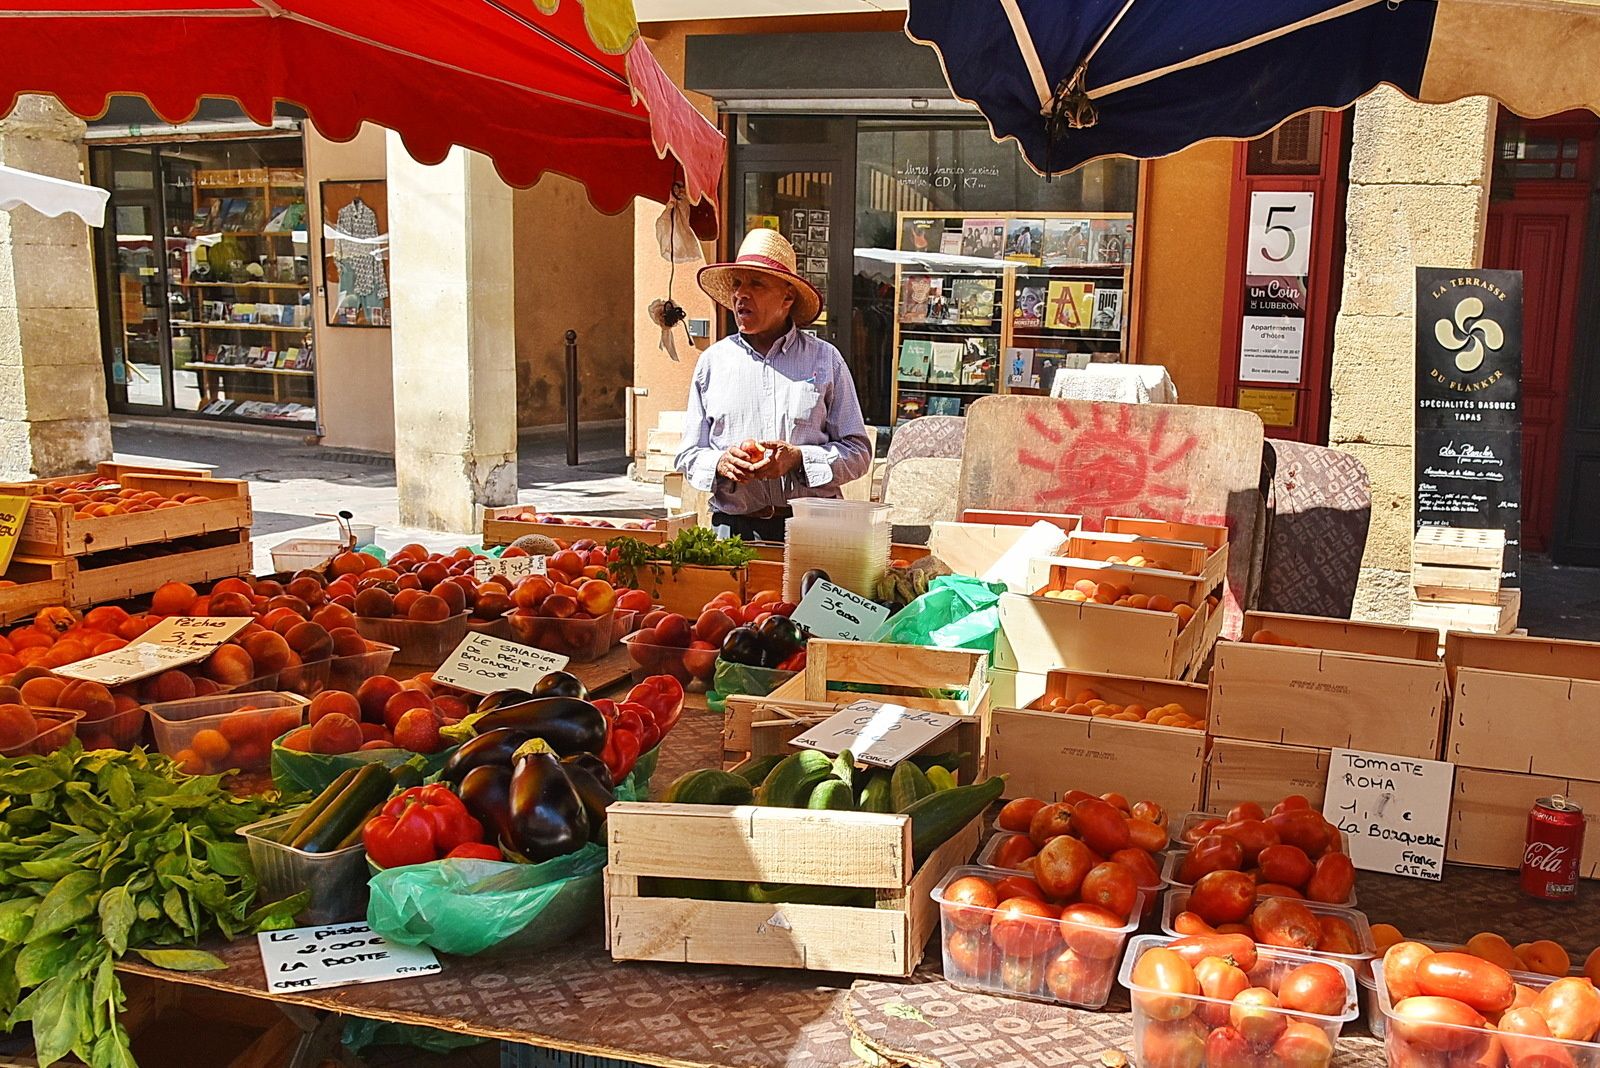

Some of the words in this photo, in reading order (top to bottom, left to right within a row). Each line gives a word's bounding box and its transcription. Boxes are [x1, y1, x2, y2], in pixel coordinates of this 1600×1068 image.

[1261, 206, 1296, 262] 5
[1251, 287, 1266, 298] Un
[1268, 280, 1300, 299] Coin
[1432, 285, 1447, 299] LA
[1450, 277, 1507, 301] TERRASSE
[1259, 301, 1300, 310] LUBERON
[1250, 324, 1296, 332] Appartements
[1430, 368, 1446, 383] DU
[1450, 369, 1504, 392] FLANKER
[1420, 399, 1475, 410] SPÉCIALITÉS
[1478, 401, 1516, 411] BASQUES
[1455, 413, 1482, 422] TAPAS
[820, 582, 877, 613] SALADiER
[174, 617, 227, 628] Pêches
[161, 631, 186, 643] 3
[473, 635, 492, 647] LE
[1338, 816, 1360, 834] La
[1368, 824, 1443, 847] Barquette
[1402, 851, 1437, 869] France
[280, 962, 308, 972] LA
